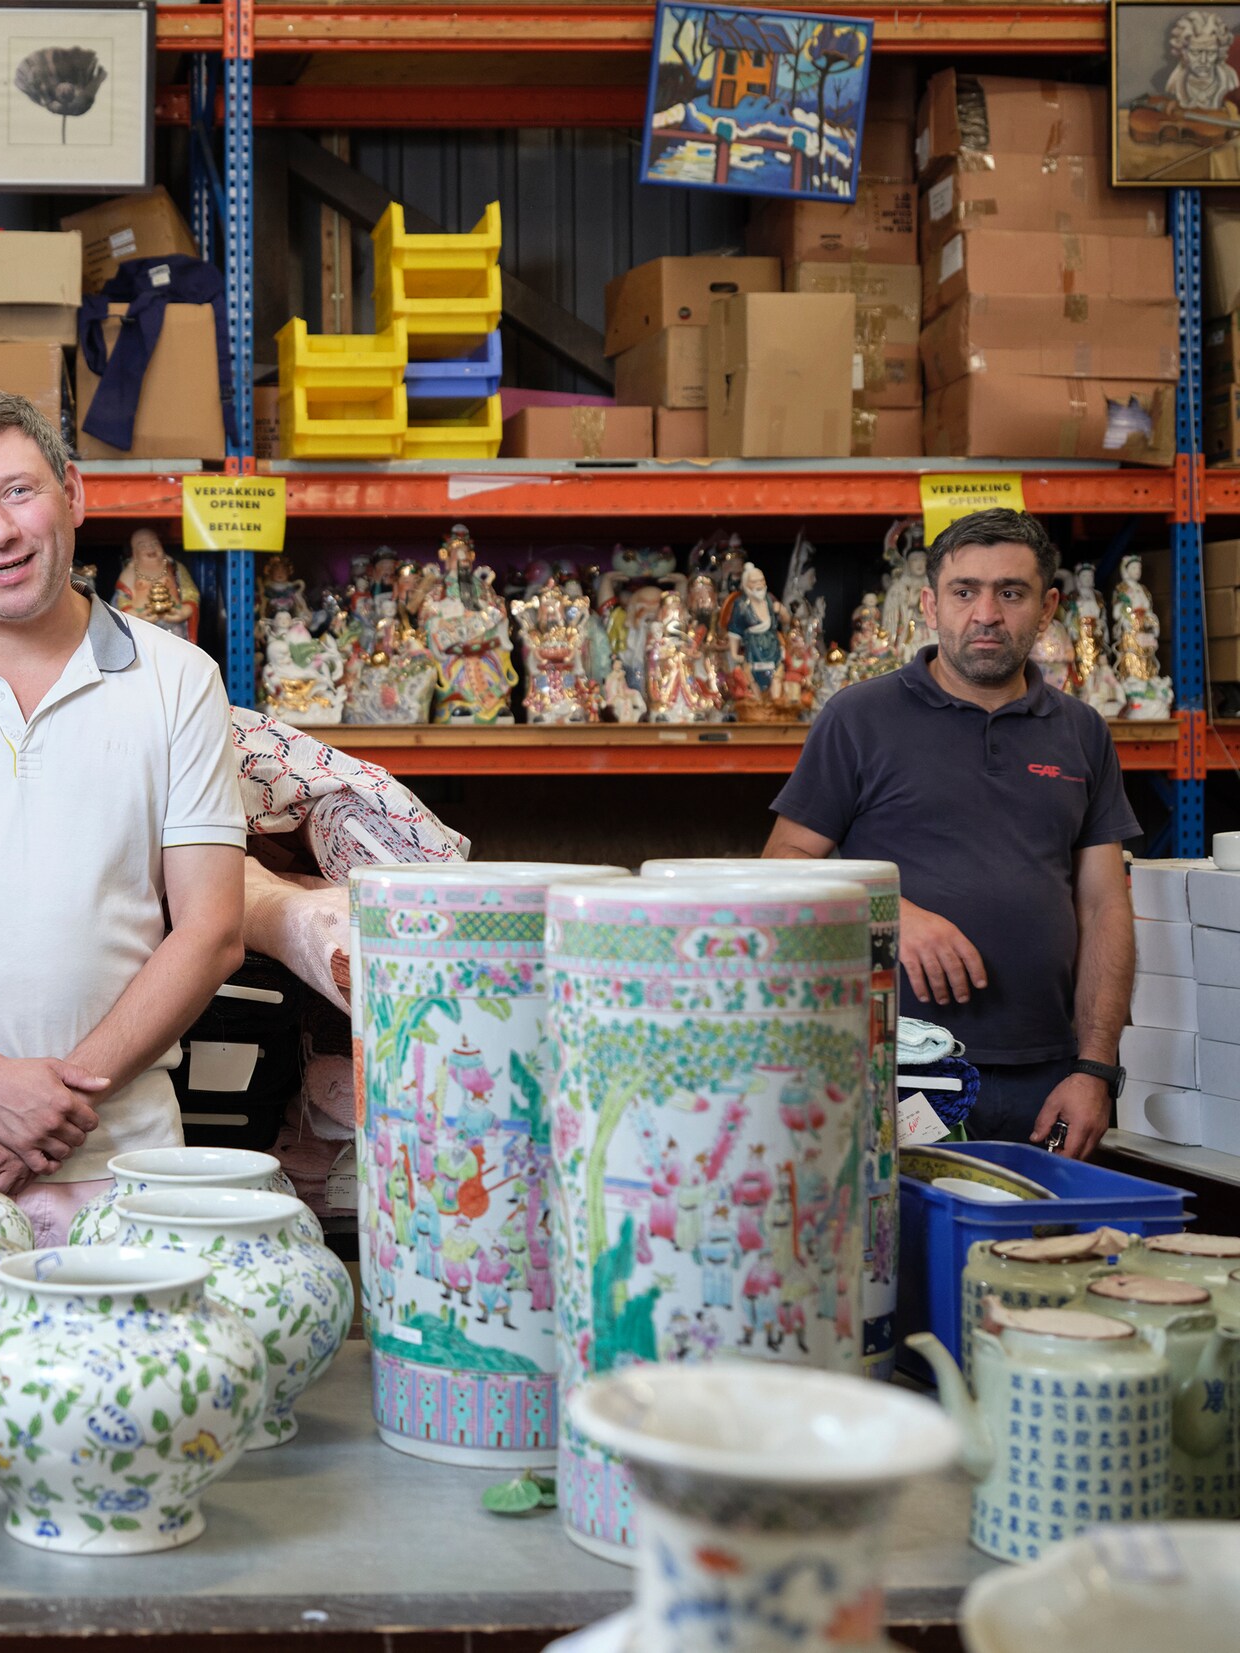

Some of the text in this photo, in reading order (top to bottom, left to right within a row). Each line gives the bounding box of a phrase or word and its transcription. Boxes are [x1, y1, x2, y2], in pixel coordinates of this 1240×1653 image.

[194, 487, 276, 497] VERPAKKING
[931, 483, 1012, 494] VERPAKKING
[209, 500, 261, 510] OPENEN
[948, 495, 999, 505] OPENEN
[209, 522, 262, 531] BETALEN
